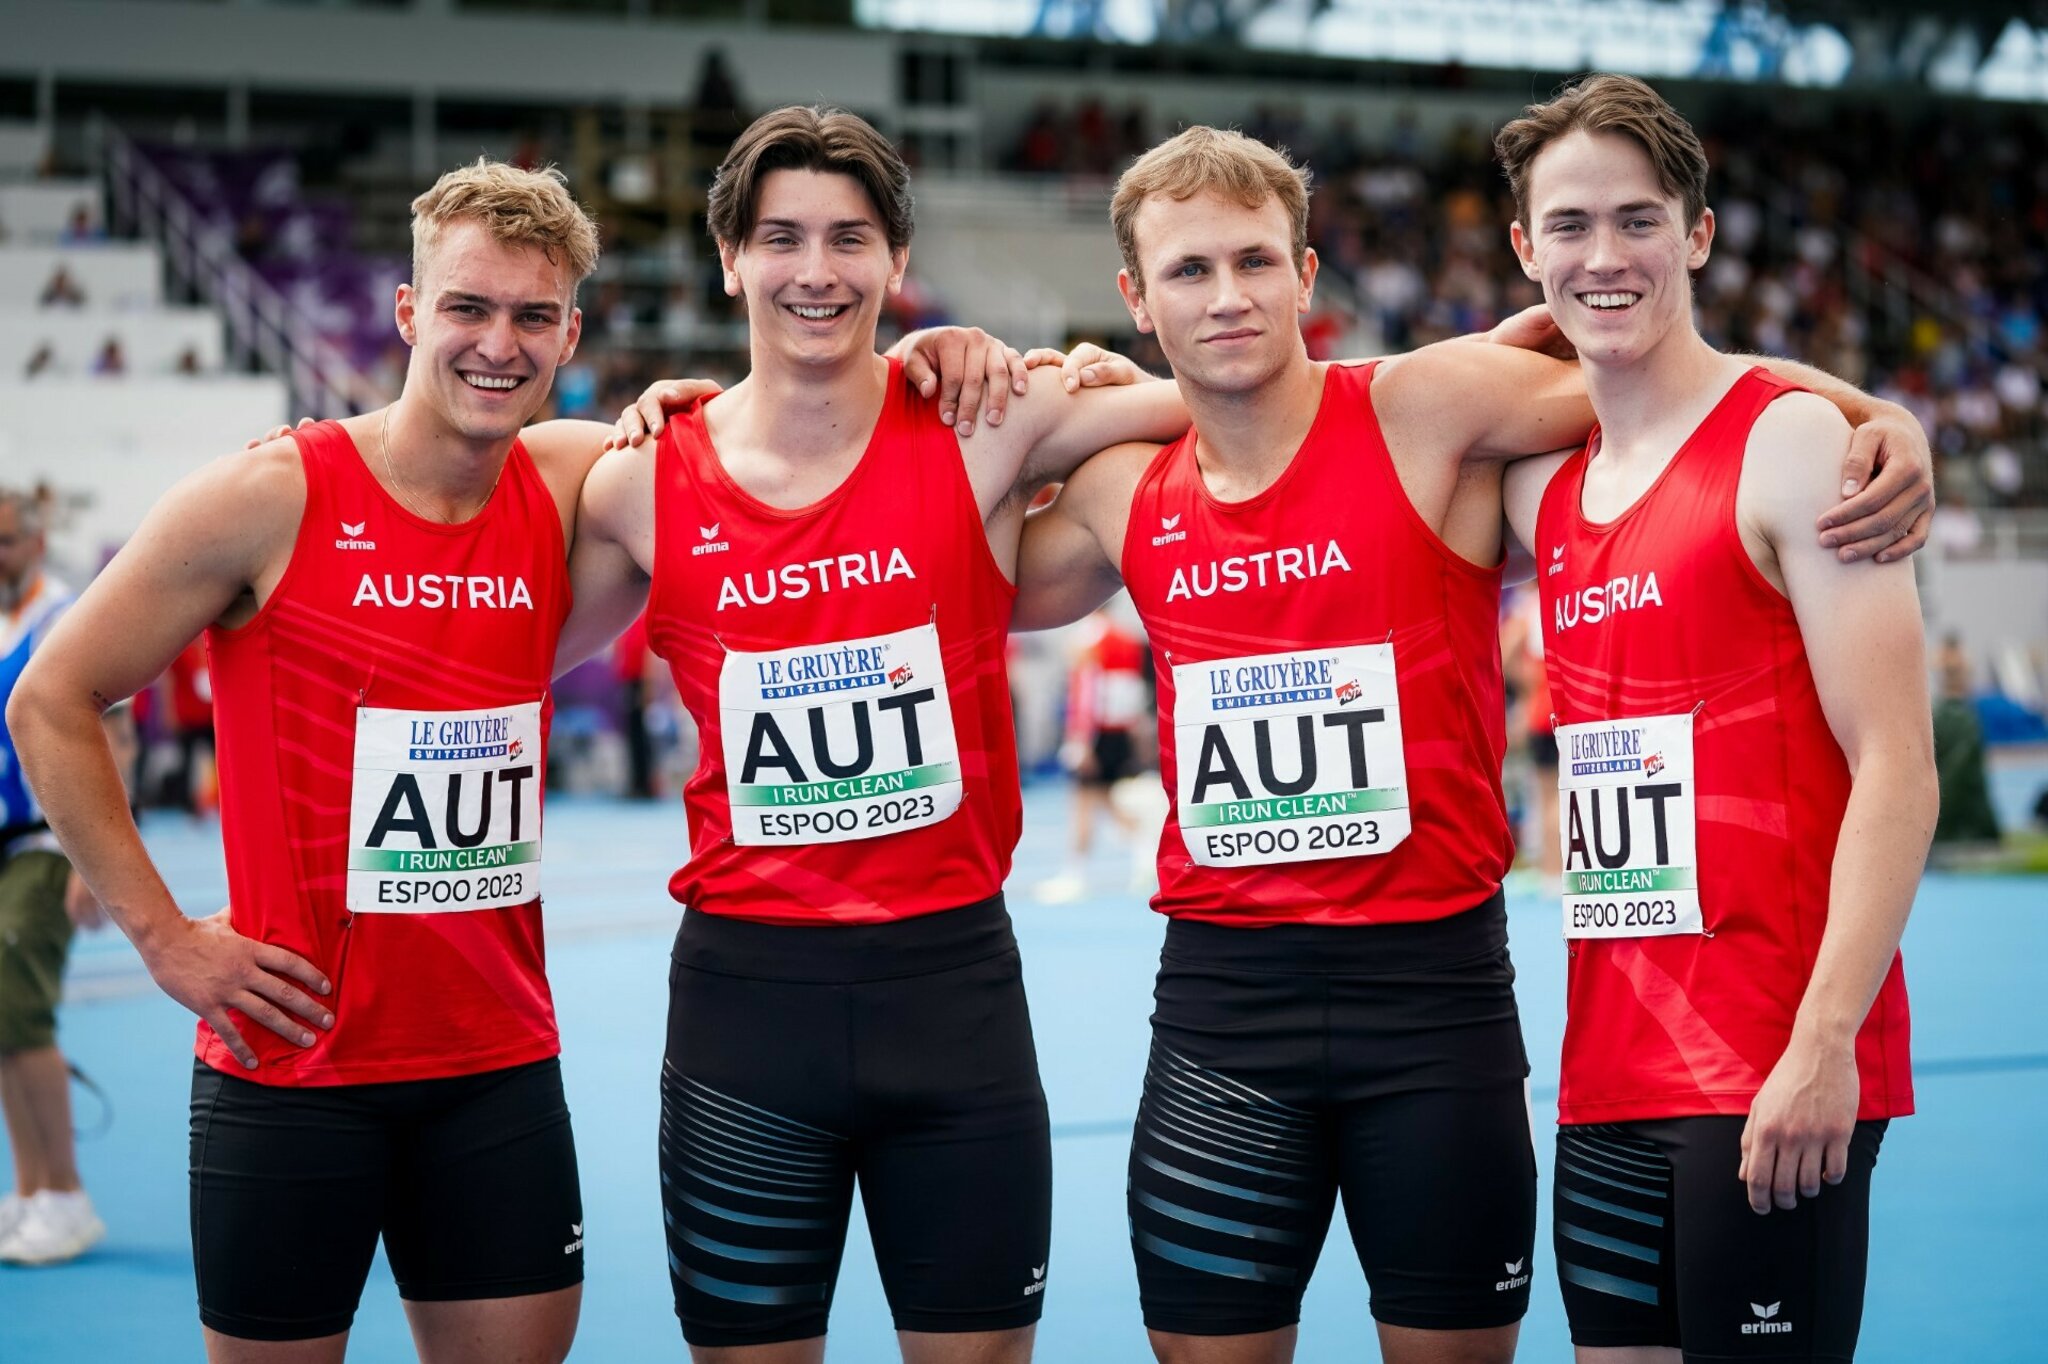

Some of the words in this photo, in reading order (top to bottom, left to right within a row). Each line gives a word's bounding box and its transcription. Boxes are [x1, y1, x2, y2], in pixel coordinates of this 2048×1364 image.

[335, 538, 376, 550] erima
[692, 540, 729, 556] erima
[1152, 529, 1186, 546] erima
[716, 547, 916, 612] AUSTRIA
[1166, 539, 1352, 603] AUSTRIA
[352, 574, 534, 610] AUSTRIA
[1555, 571, 1663, 635] AUSTRIA
[758, 659, 783, 685] LE
[1210, 669, 1231, 695] LE
[766, 675, 880, 698] SWITZERLAND
[1216, 689, 1328, 709] SWITZERLAND
[410, 720, 434, 745] LE
[740, 687, 935, 784] AUT
[414, 746, 504, 759] SWITZERLAND
[1190, 708, 1385, 805] AUT
[1571, 734, 1581, 760] LE
[364, 765, 533, 850] AUT
[773, 788, 780, 804] I
[783, 785, 829, 804] RUN
[759, 808, 859, 836] ESPOO
[866, 795, 935, 828] 2023
[1219, 805, 1224, 822] I
[1228, 802, 1272, 822] RUN
[1206, 828, 1300, 858] ESPOO
[1307, 820, 1380, 850] 2023
[1565, 783, 1682, 871] AUT
[400, 853, 405, 869] I
[410, 853, 452, 870] RUN
[378, 879, 471, 904] ESPOO
[476, 872, 523, 900] 2023
[1582, 874, 1602, 892] RUN
[1573, 902, 1619, 928] ESPOO
[1624, 899, 1677, 926] 2023
[1741, 1320, 1793, 1334] erima
